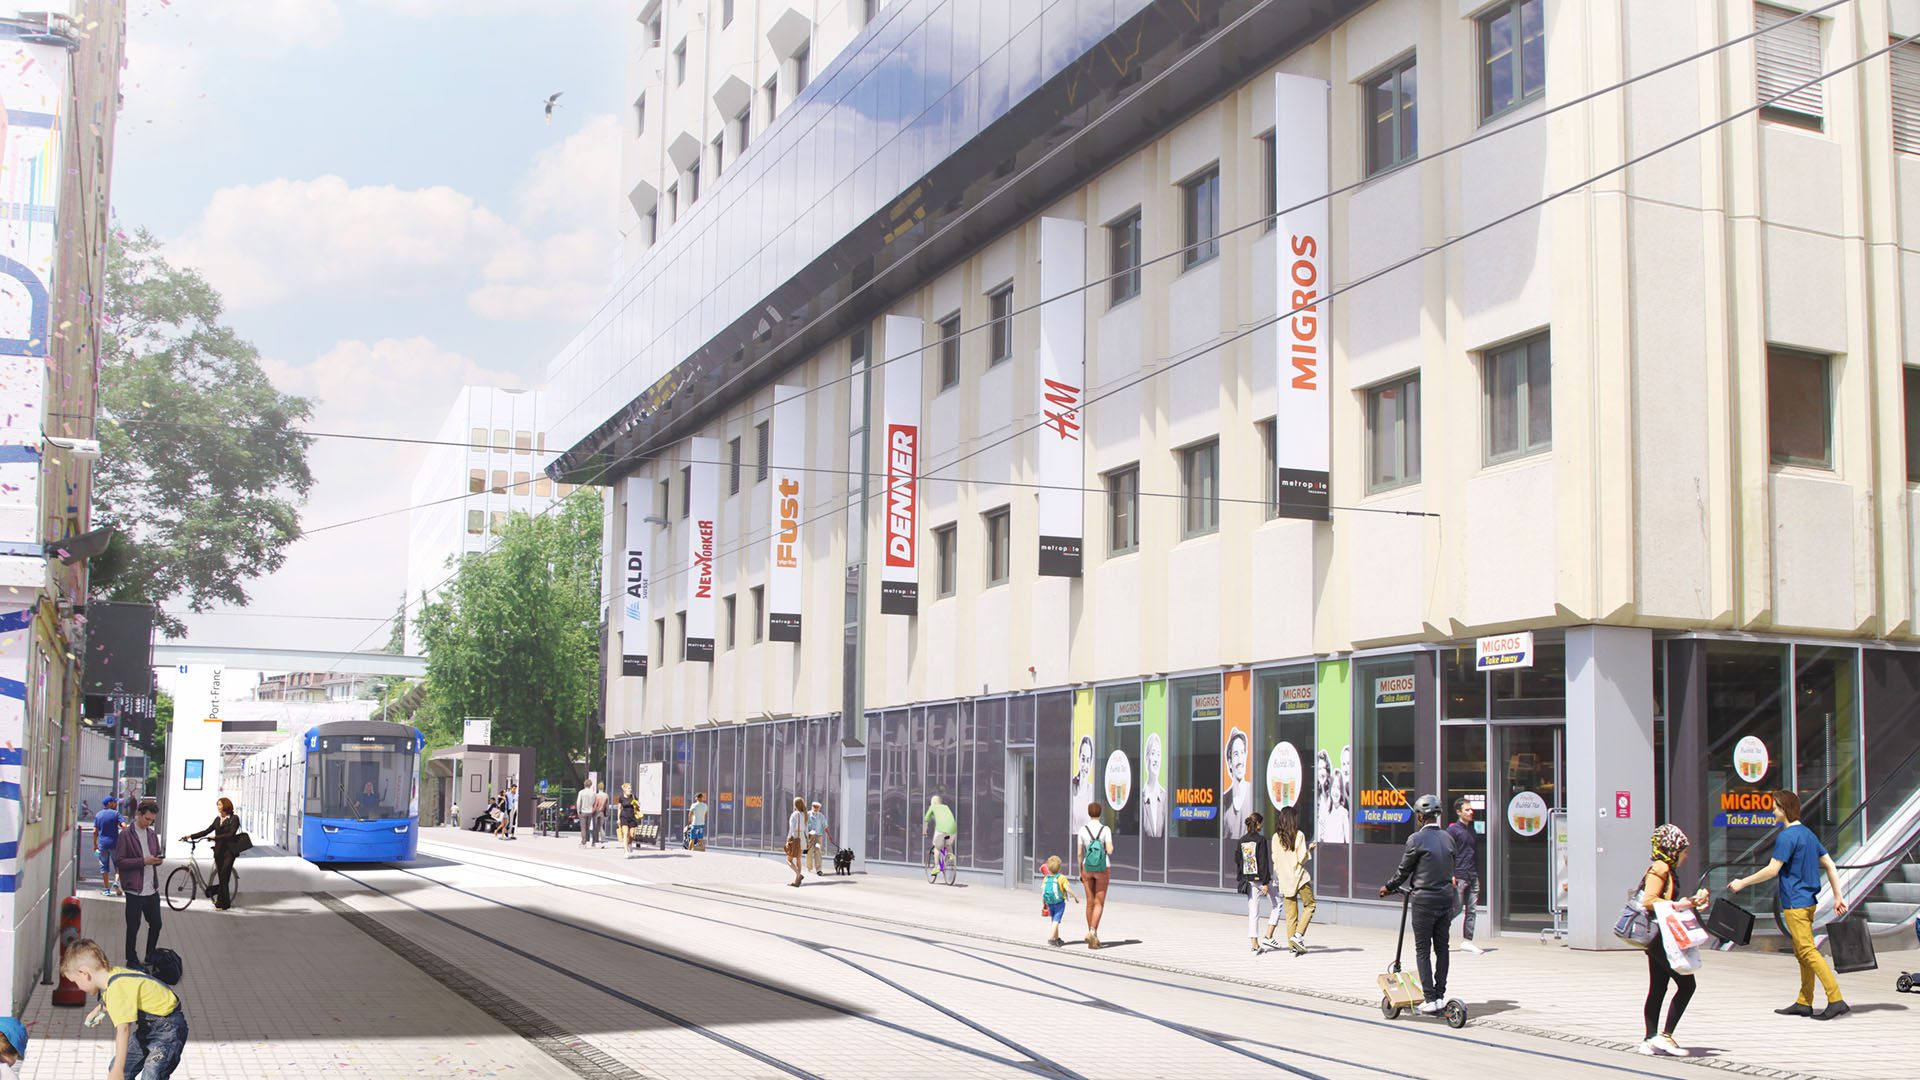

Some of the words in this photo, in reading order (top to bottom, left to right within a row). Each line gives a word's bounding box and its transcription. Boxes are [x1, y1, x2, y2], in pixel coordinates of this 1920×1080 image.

[1291, 234, 1317, 390] MIGROS
[1044, 378, 1081, 440] H&M
[890, 430, 913, 561] DENNER
[627, 551, 643, 599] ALDI
[1482, 637, 1521, 653] MIGROS
[1485, 656, 1499, 665] Take
[1500, 655, 1518, 664] Away
[1380, 678, 1413, 692] MIGROS
[209, 669, 221, 719] Port-Franc
[1195, 696, 1219, 707] MIGROS
[1283, 687, 1311, 700] MIGROS
[1176, 787, 1213, 804] MIGROS
[1361, 789, 1406, 806] MIGROS
[1721, 793, 1773, 810] MIGRO
[1179, 808, 1193, 817] Take
[1194, 807, 1210, 818] Away
[1364, 811, 1381, 821] Take
[1382, 811, 1403, 822] Away
[1726, 814, 1749, 824] Take
[1751, 814, 1777, 826] Away
